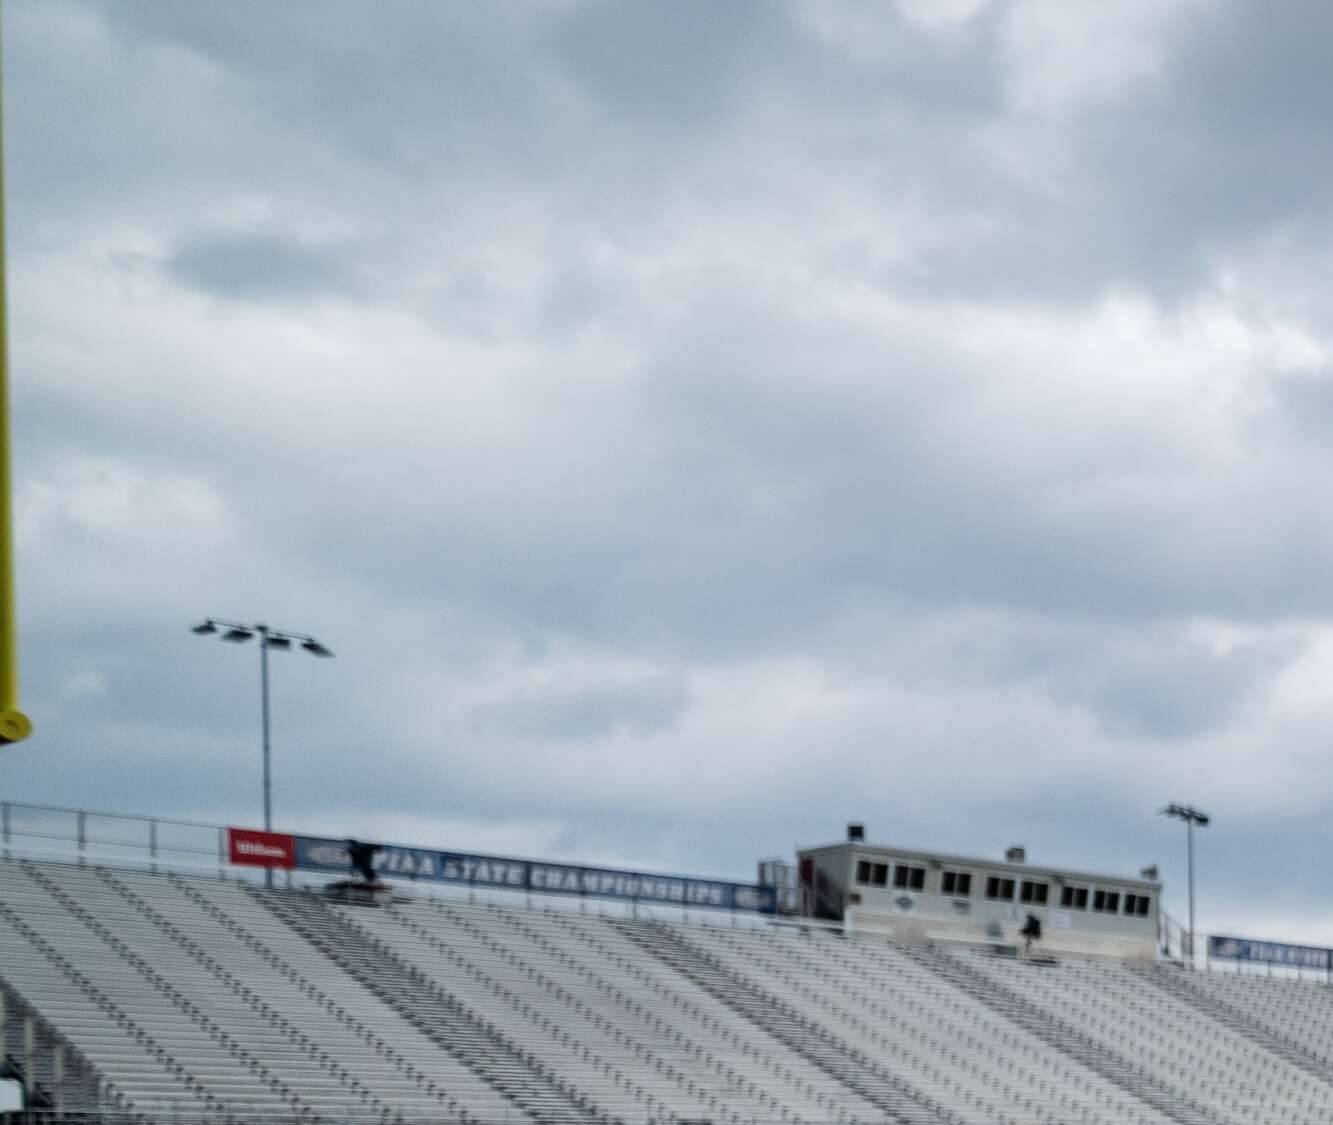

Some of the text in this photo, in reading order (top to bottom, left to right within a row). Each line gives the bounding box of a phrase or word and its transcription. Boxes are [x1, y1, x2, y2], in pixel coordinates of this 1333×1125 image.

[373, 846, 435, 877] PIAA
[442, 855, 525, 887] STATE
[529, 866, 722, 906] CHAMPIONSHIPS
